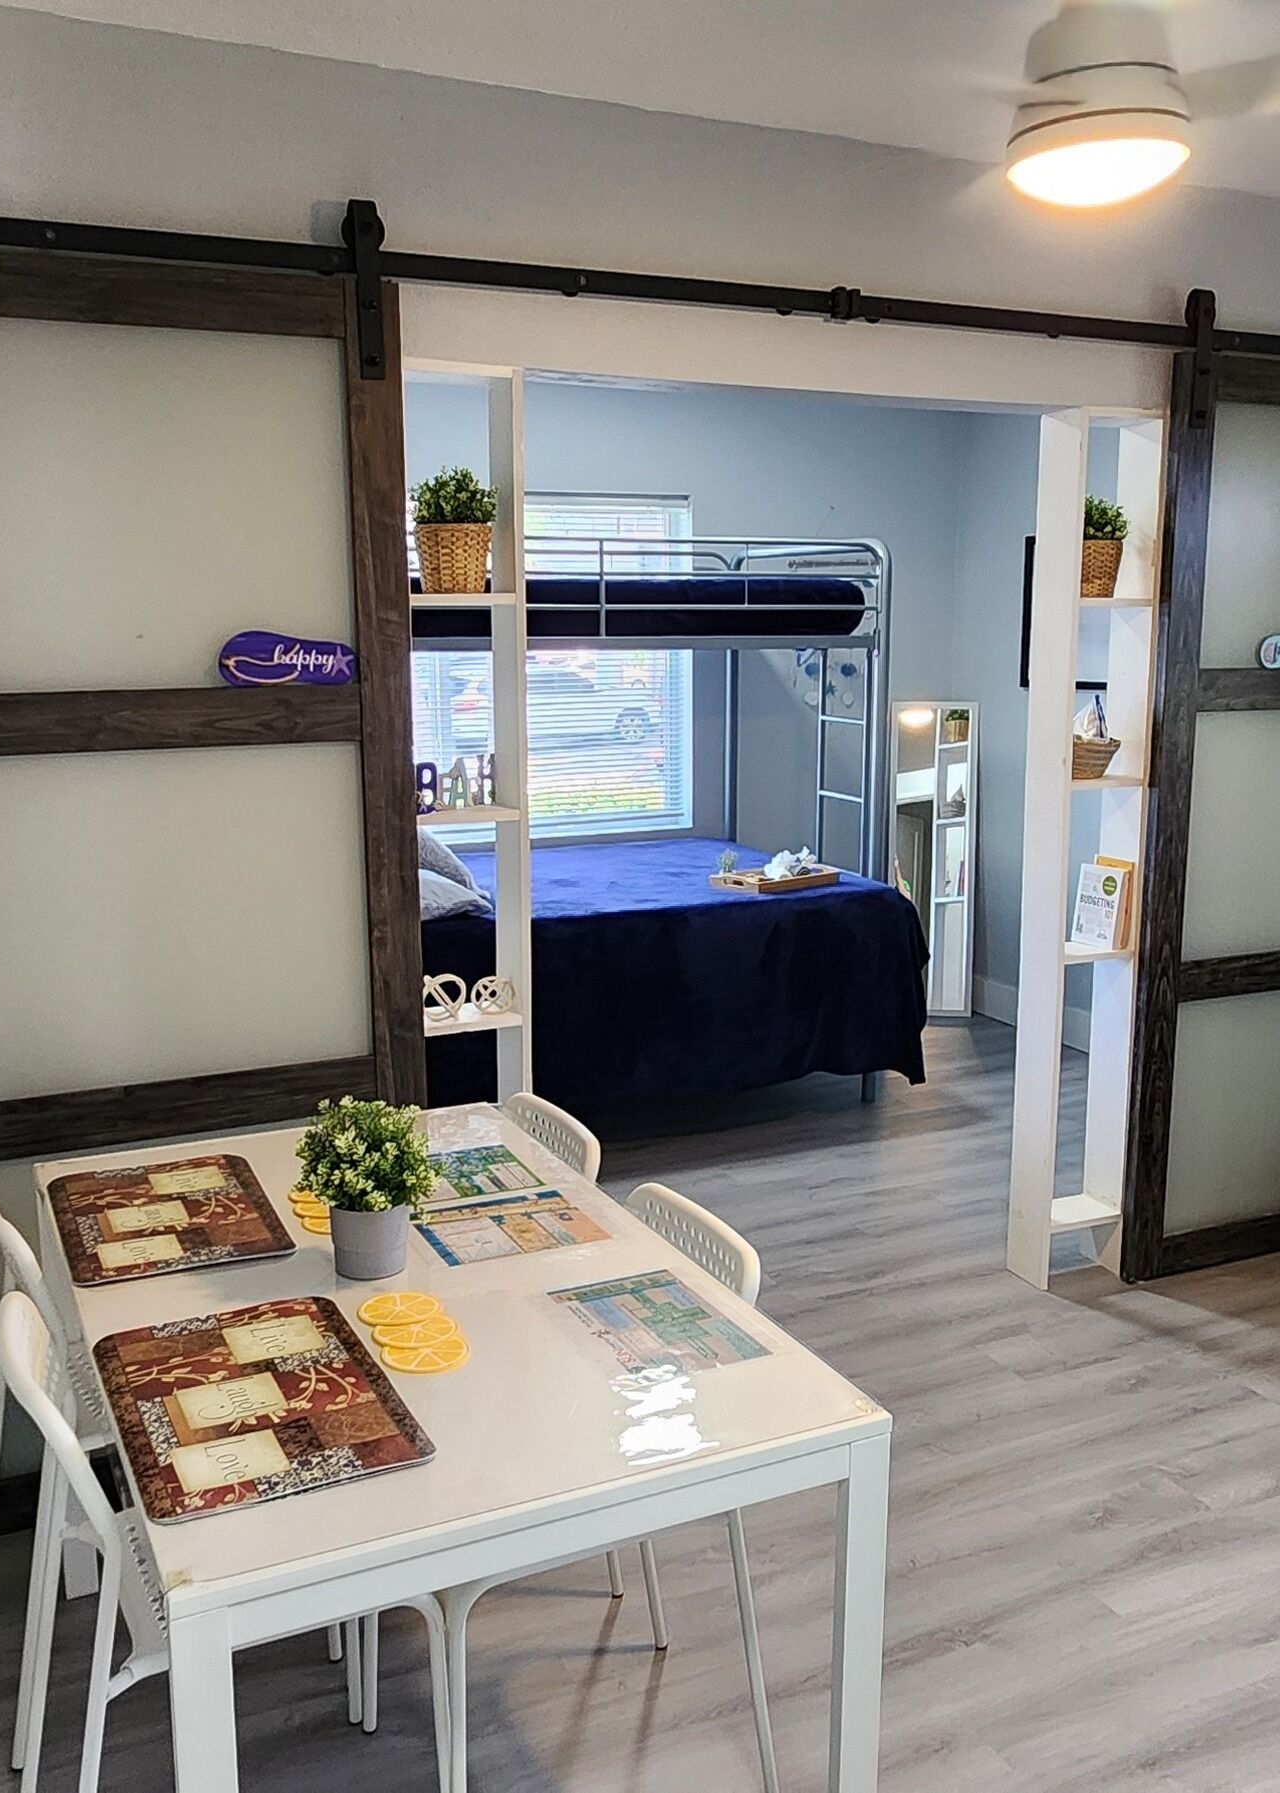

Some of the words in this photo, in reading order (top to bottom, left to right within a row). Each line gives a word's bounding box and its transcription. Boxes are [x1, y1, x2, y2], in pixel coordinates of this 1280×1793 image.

[274, 643, 334, 673] happy
[1080, 893, 1115, 910] BUDGETING
[250, 1323, 286, 1354] Live
[198, 1376, 280, 1420] Laugh
[205, 1439, 249, 1480] Love
